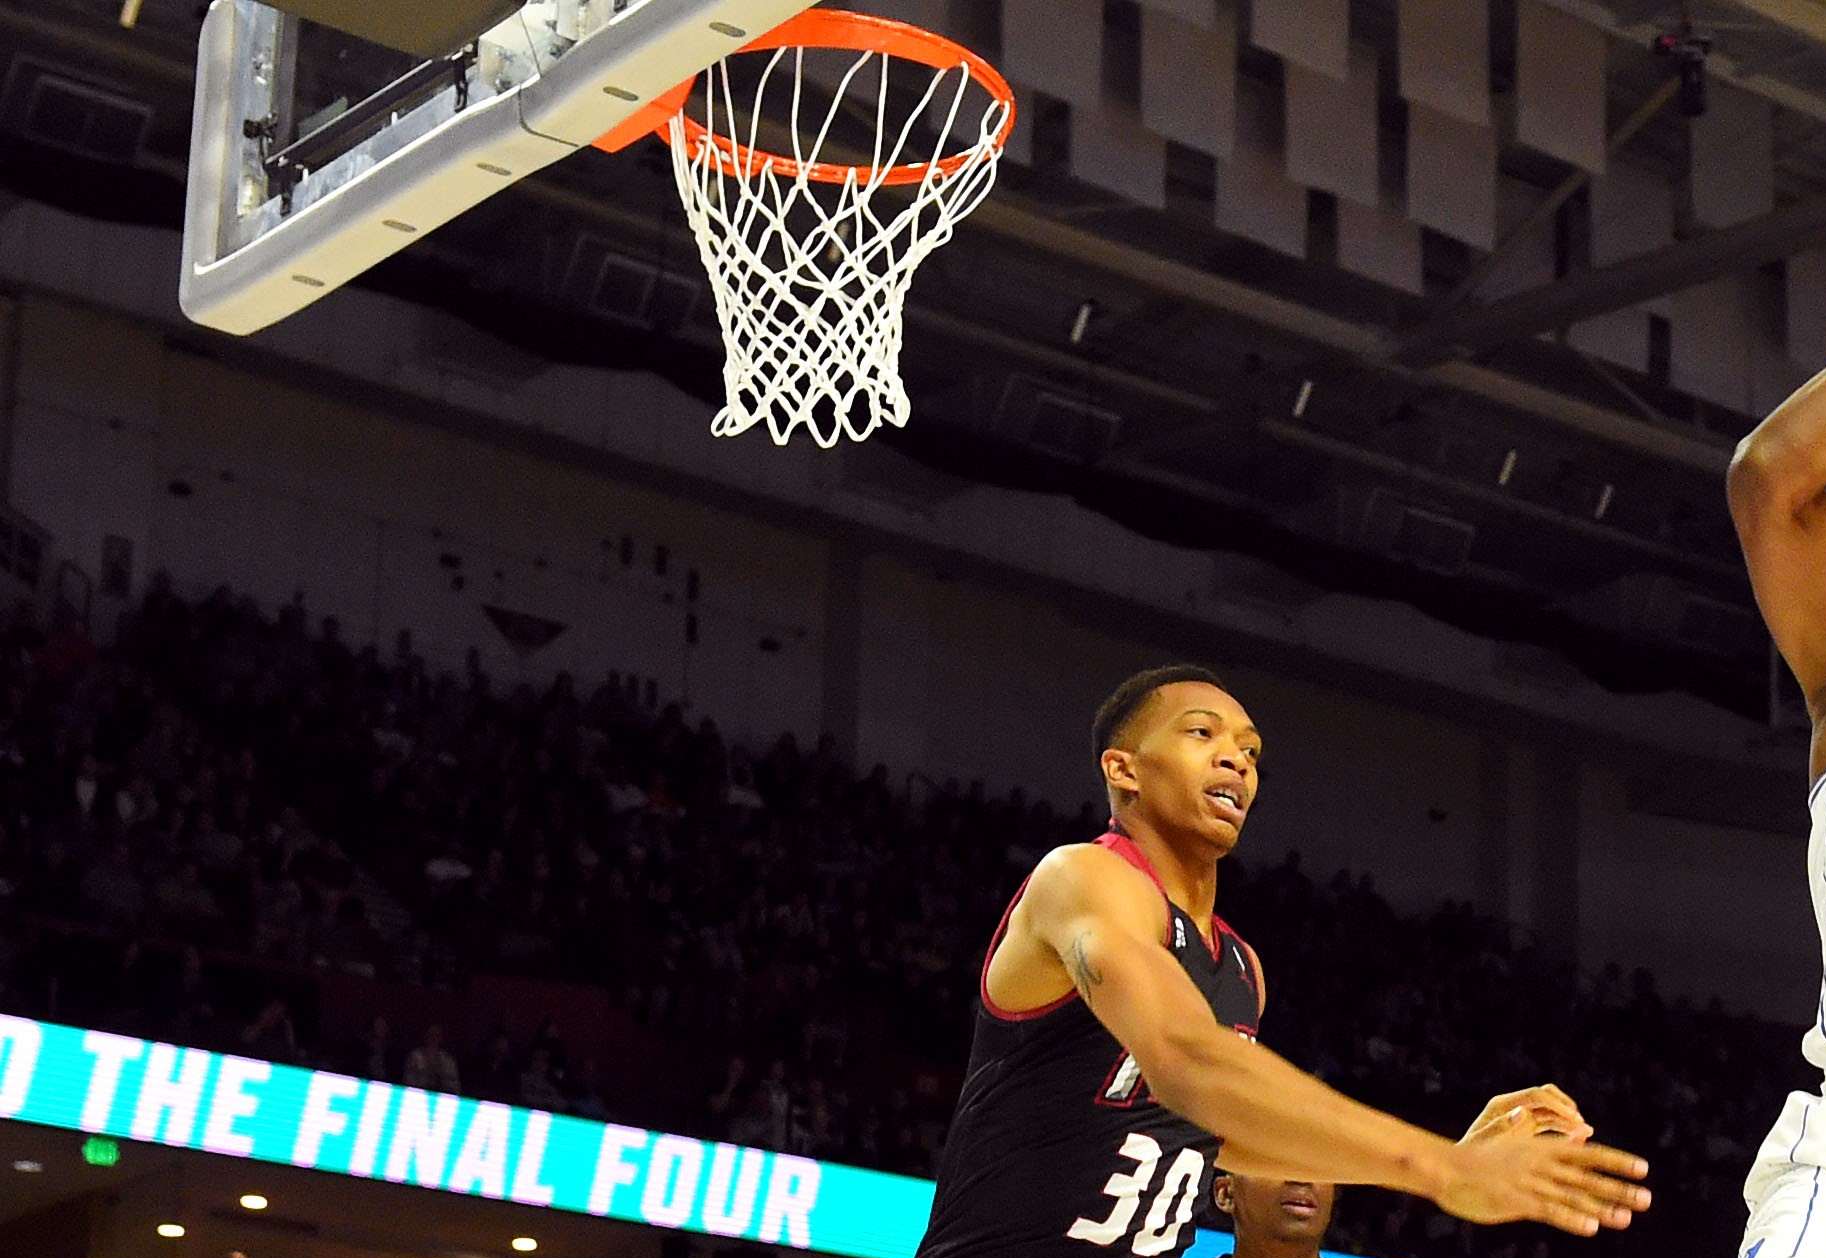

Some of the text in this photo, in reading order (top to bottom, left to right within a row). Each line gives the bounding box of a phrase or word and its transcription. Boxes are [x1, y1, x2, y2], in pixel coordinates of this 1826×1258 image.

[80, 1029, 271, 1157] THE
[292, 1069, 554, 1206] FINAL
[587, 1123, 822, 1248] FOUR
[1065, 1132, 1204, 1257] 30
